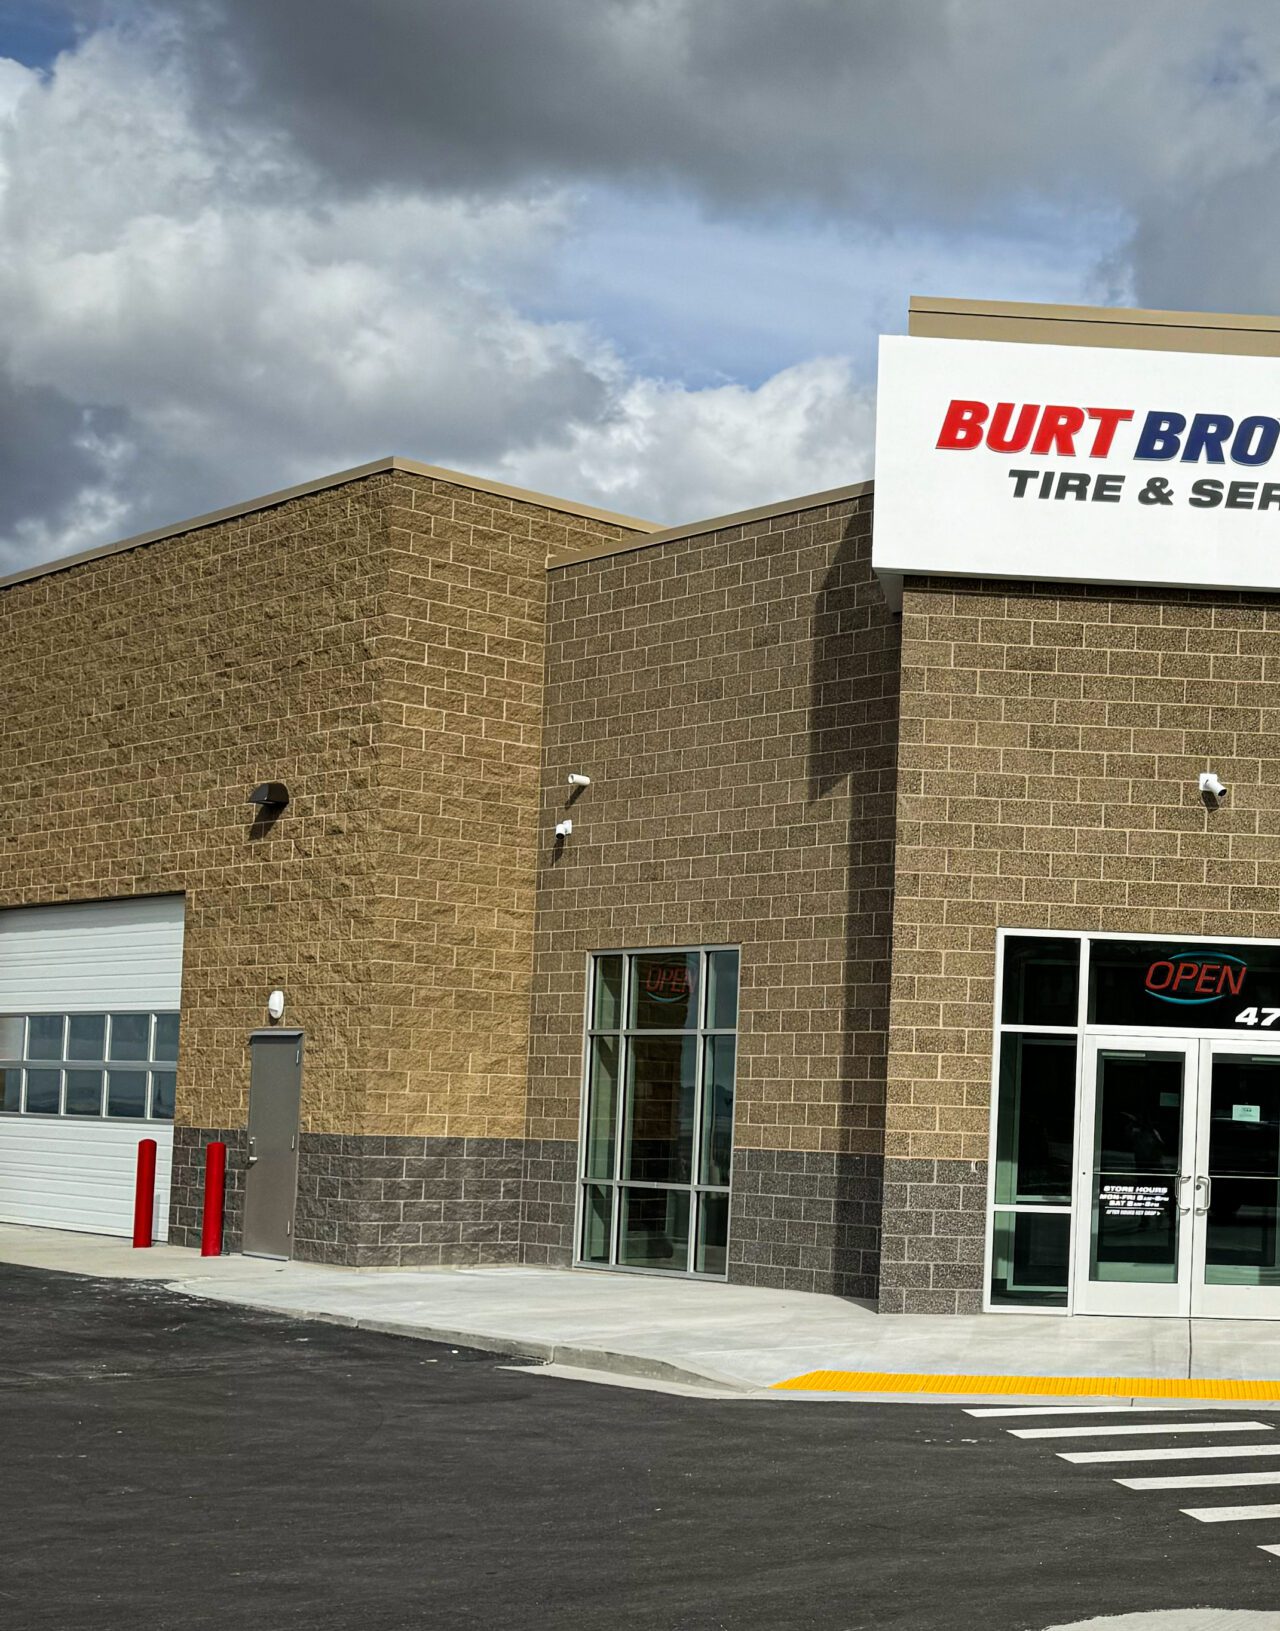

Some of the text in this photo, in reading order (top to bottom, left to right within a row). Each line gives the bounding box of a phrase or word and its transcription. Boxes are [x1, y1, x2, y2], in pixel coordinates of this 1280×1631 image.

[935, 399, 1135, 459] BURT
[1008, 468, 1125, 503] TIRE
[1138, 476, 1174, 506] &
[646, 966, 698, 993] OPEN
[1145, 961, 1247, 995] OPEN
[1103, 1185, 1168, 1194] STORE HOURS
